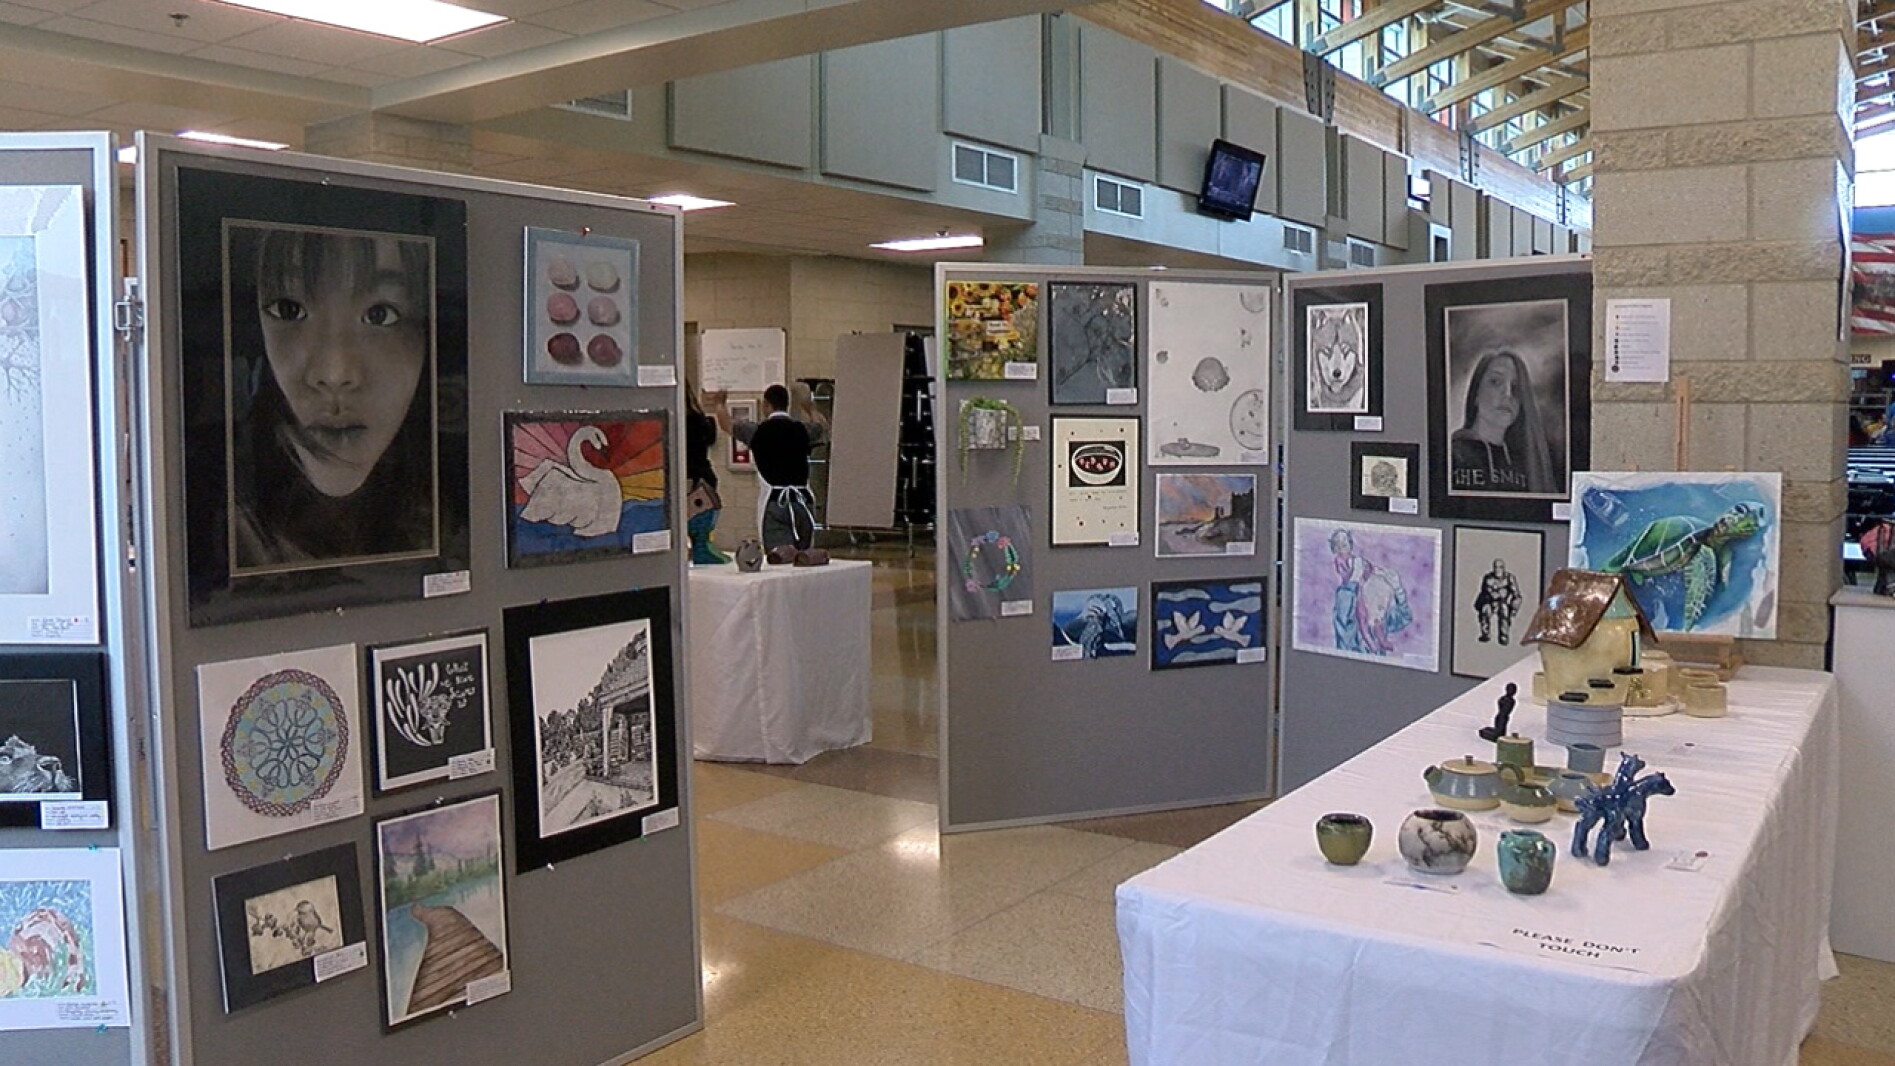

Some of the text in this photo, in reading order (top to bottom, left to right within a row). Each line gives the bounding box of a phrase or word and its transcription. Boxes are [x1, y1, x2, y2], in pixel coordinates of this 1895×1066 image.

[1454, 469, 1486, 486] THE
[1513, 928, 1640, 953] PLEASE DON'T
[1539, 943, 1600, 958] TOUCH
